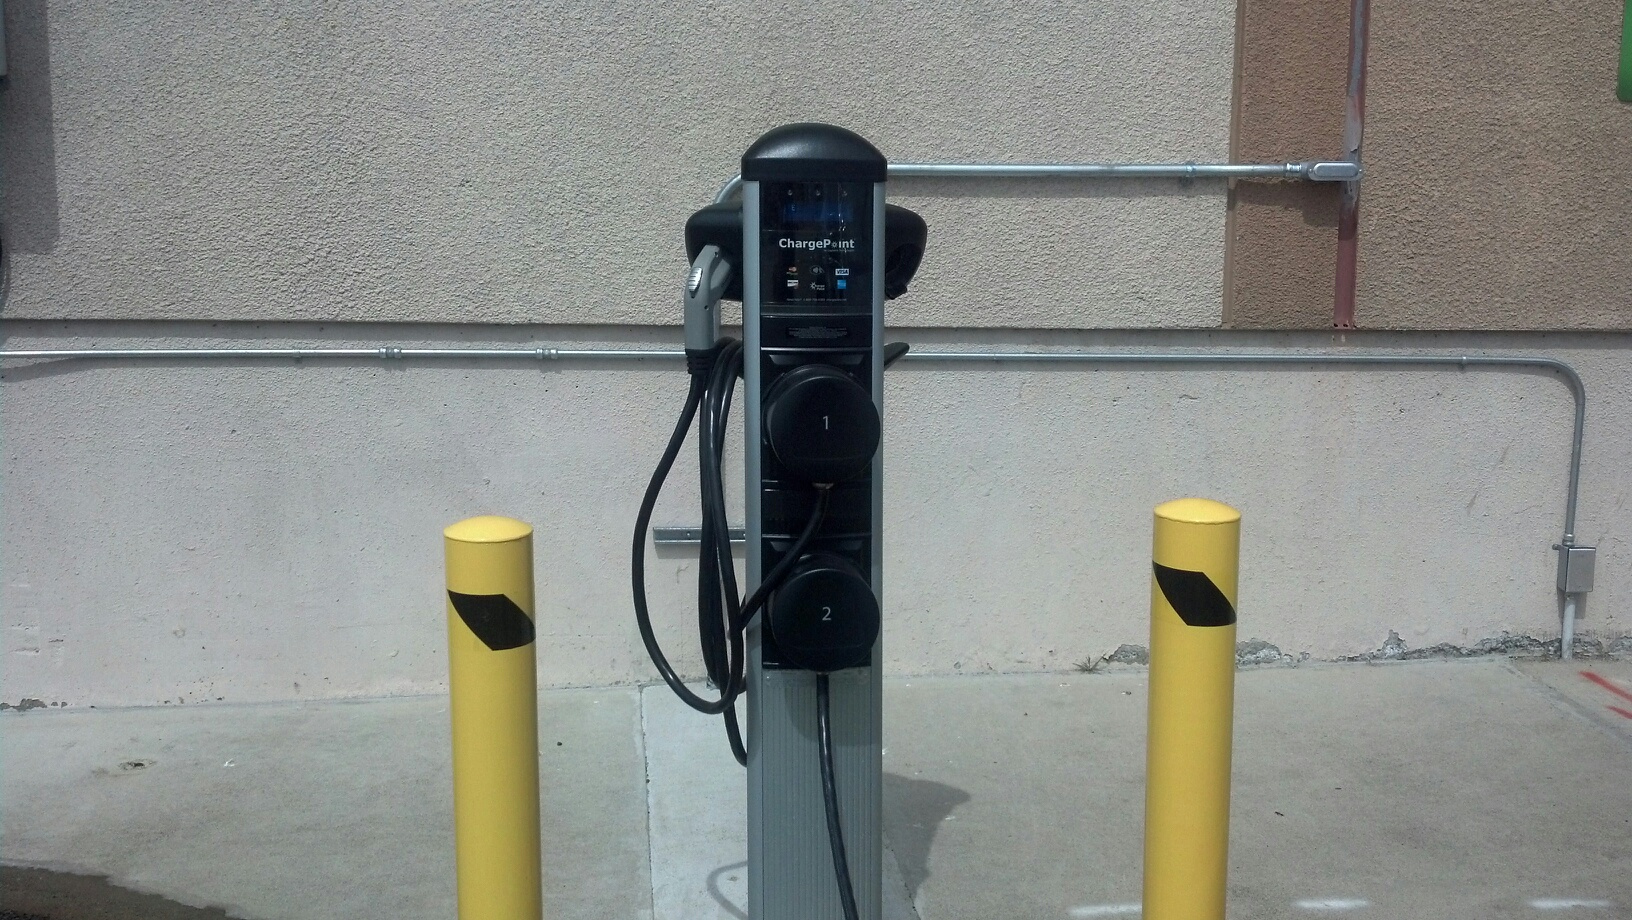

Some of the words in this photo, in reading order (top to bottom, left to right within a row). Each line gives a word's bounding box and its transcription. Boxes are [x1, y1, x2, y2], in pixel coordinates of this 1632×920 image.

[778, 238, 855, 251] ChargePoint
[822, 415, 829, 430] 1
[822, 606, 831, 621] 2
